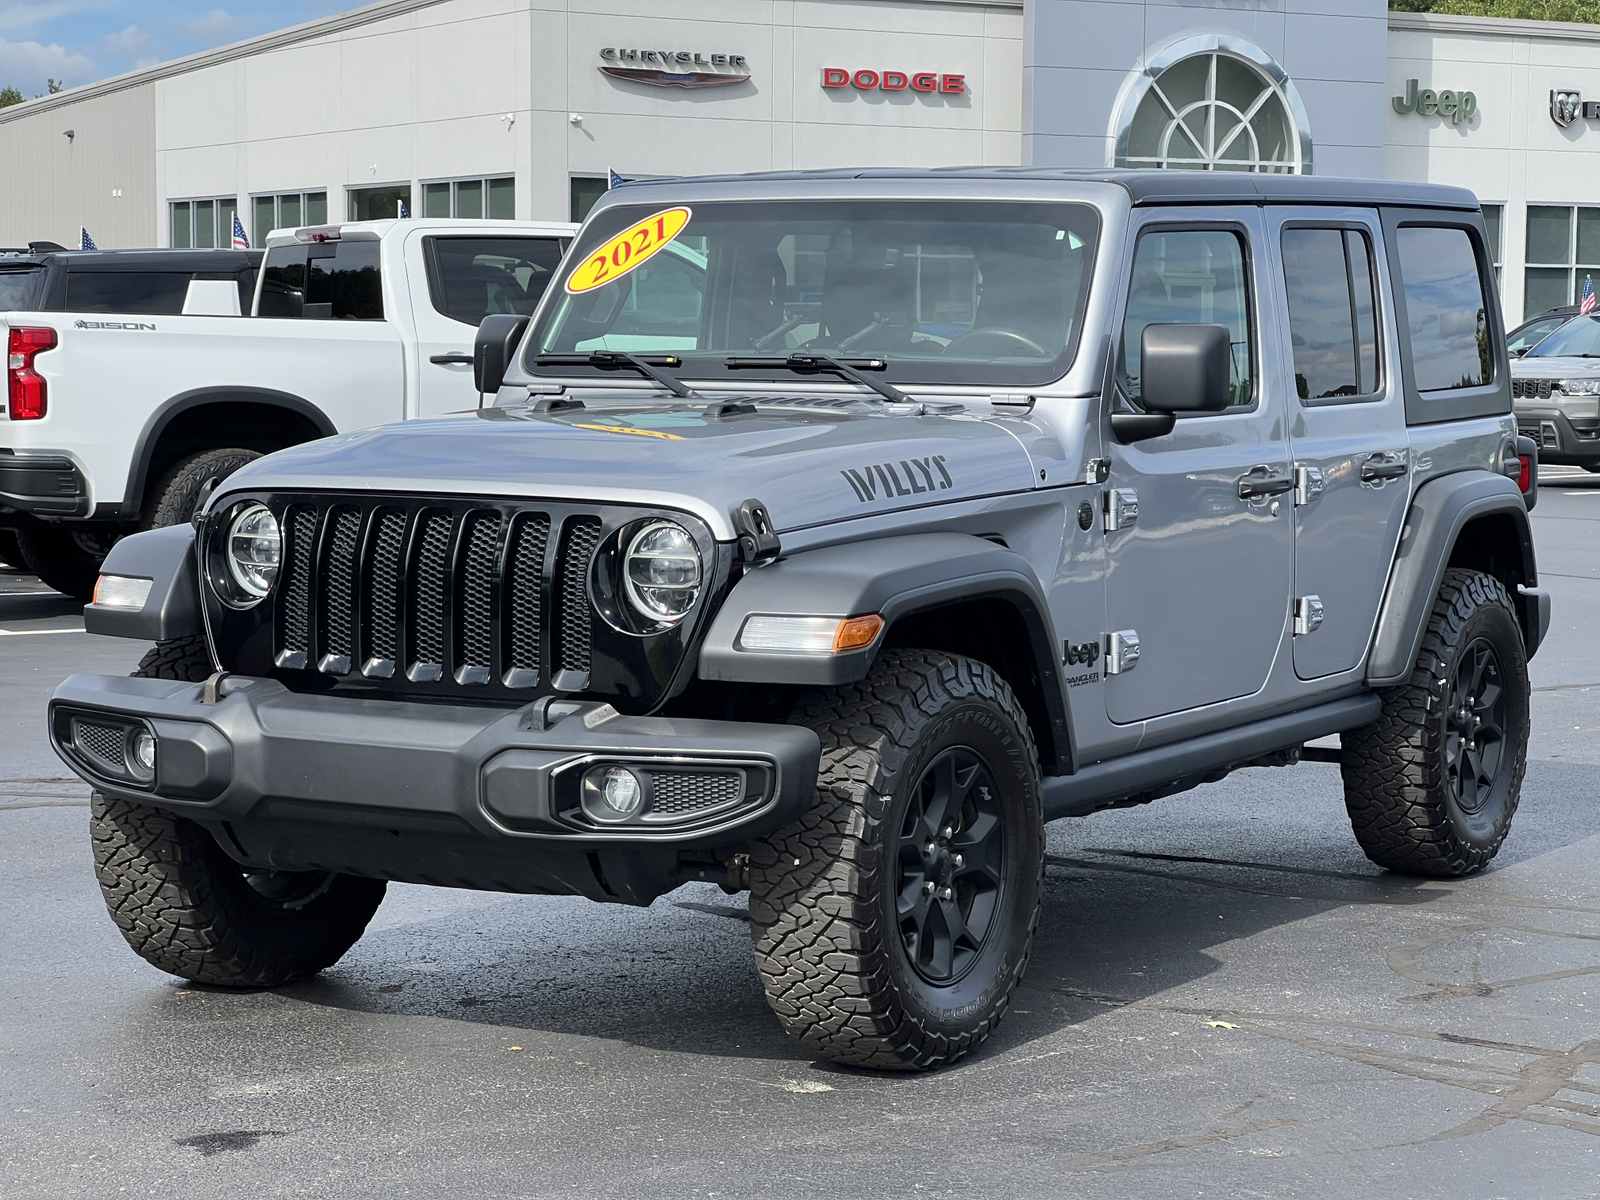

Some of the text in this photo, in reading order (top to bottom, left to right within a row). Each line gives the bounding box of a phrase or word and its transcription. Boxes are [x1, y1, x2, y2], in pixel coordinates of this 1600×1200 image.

[600, 47, 746, 66] CHRYSLER
[821, 67, 965, 93] DODGE
[1392, 79, 1477, 125] Jeep
[589, 216, 669, 284] 2021
[86, 321, 156, 331] BISON
[840, 455, 953, 503] WILLYS
[1062, 638, 1100, 668] Jeep
[1065, 672, 1099, 684] RANGLER
